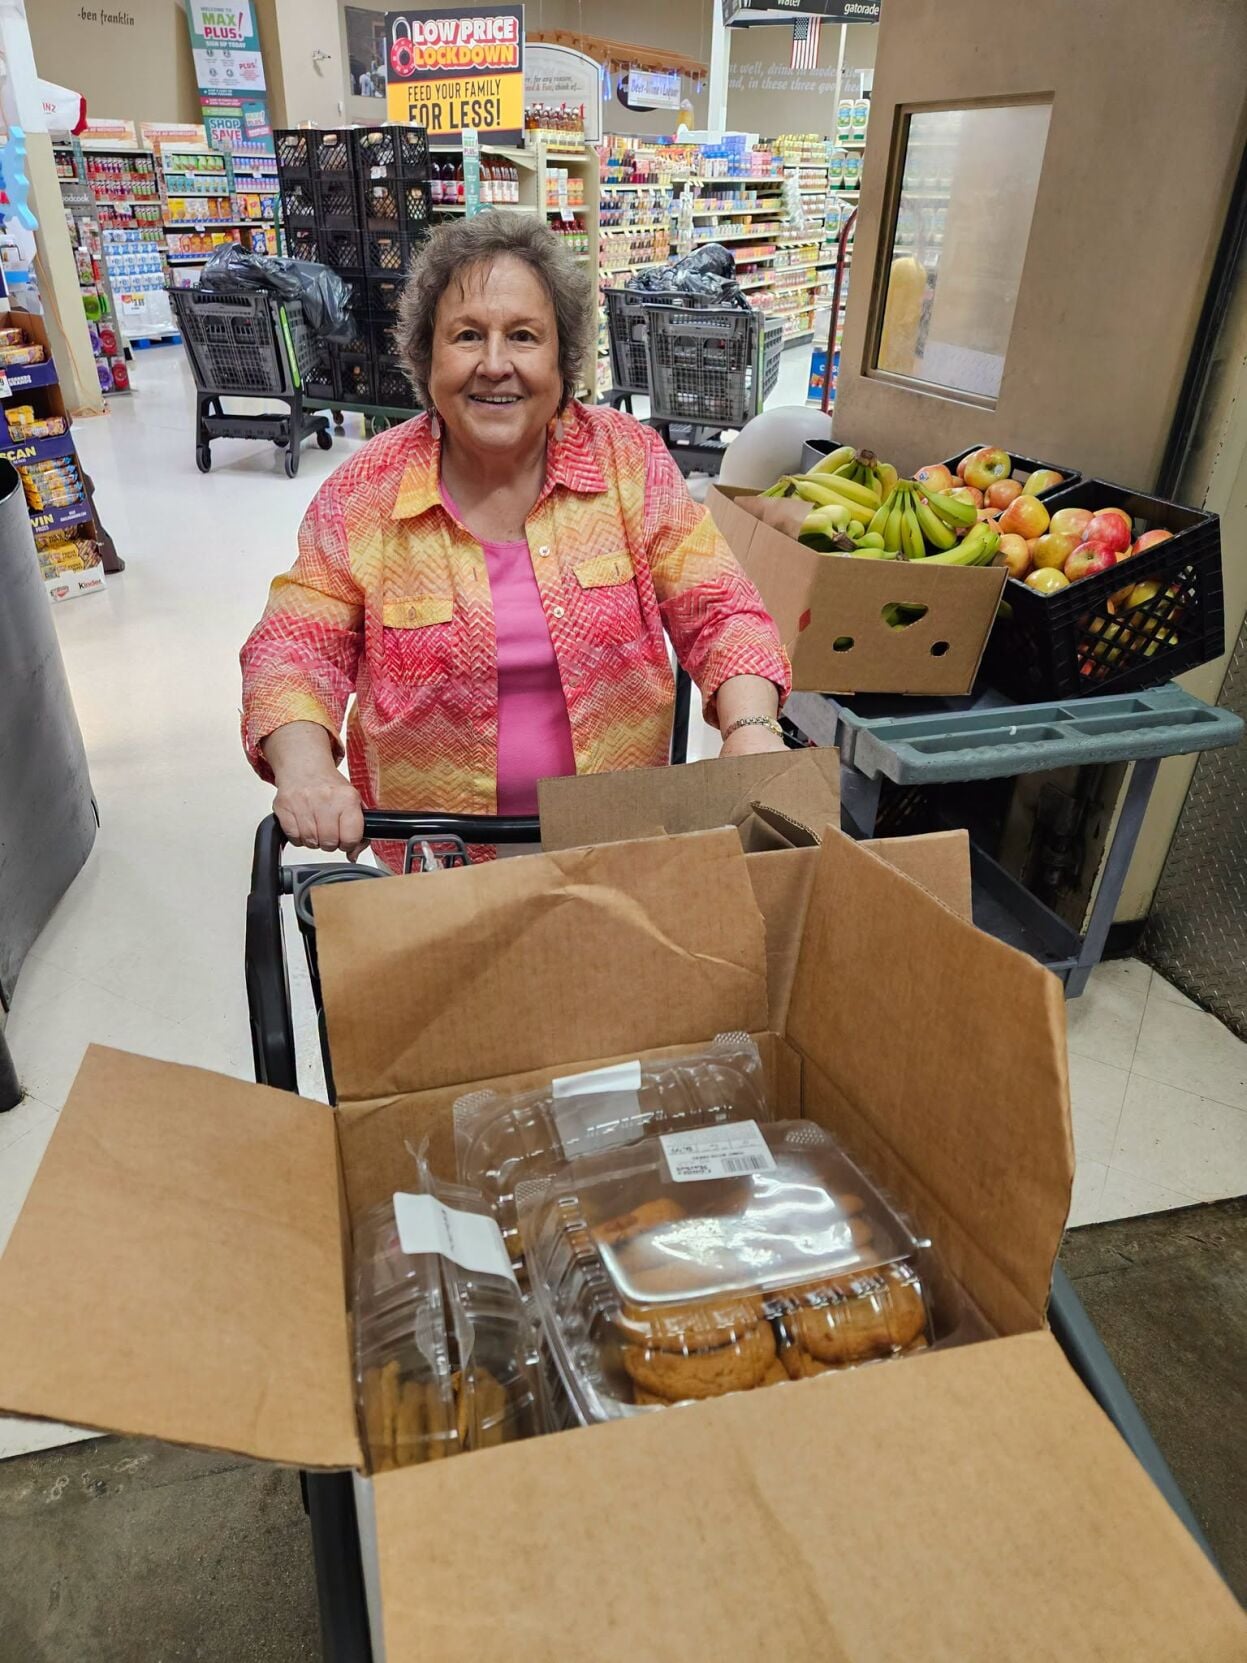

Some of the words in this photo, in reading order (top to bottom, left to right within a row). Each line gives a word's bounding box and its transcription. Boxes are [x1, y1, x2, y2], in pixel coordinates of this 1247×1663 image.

[100, 9, 135, 26] franklin
[844, 3, 880, 15] gatorade
[413, 20, 459, 44] LOW
[461, 17, 517, 43] PRICE
[413, 44, 518, 69] LOCKDOWN
[408, 86, 431, 102] FEED
[435, 83, 460, 100] YOUR
[465, 79, 501, 97] FAMILY
[209, 119, 240, 129] SHOP
[408, 103, 442, 130] FOR
[449, 98, 501, 129] LESS!
[211, 129, 242, 141] SAVE
